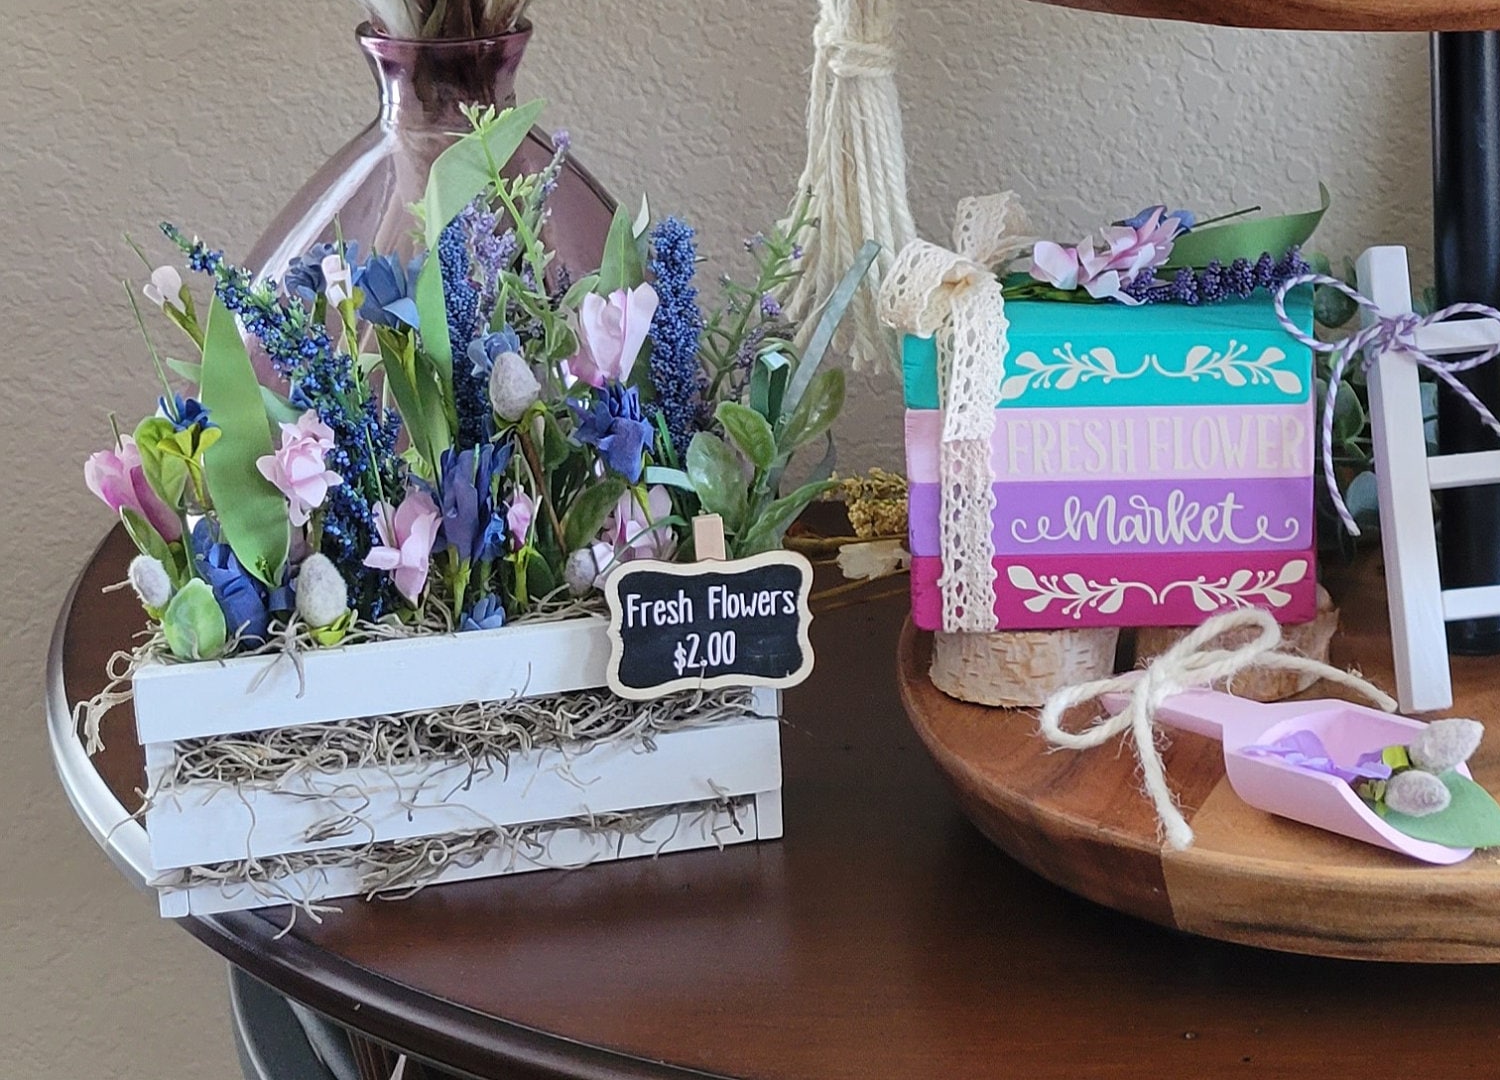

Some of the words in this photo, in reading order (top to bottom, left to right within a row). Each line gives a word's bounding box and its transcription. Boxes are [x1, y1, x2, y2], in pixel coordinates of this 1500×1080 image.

[1004, 417, 1138, 474] FRESH
[1146, 413, 1306, 471] FLOWER
[626, 589, 693, 628] Fresh
[707, 584, 796, 620] Flowers
[672, 630, 737, 676] $2.00
